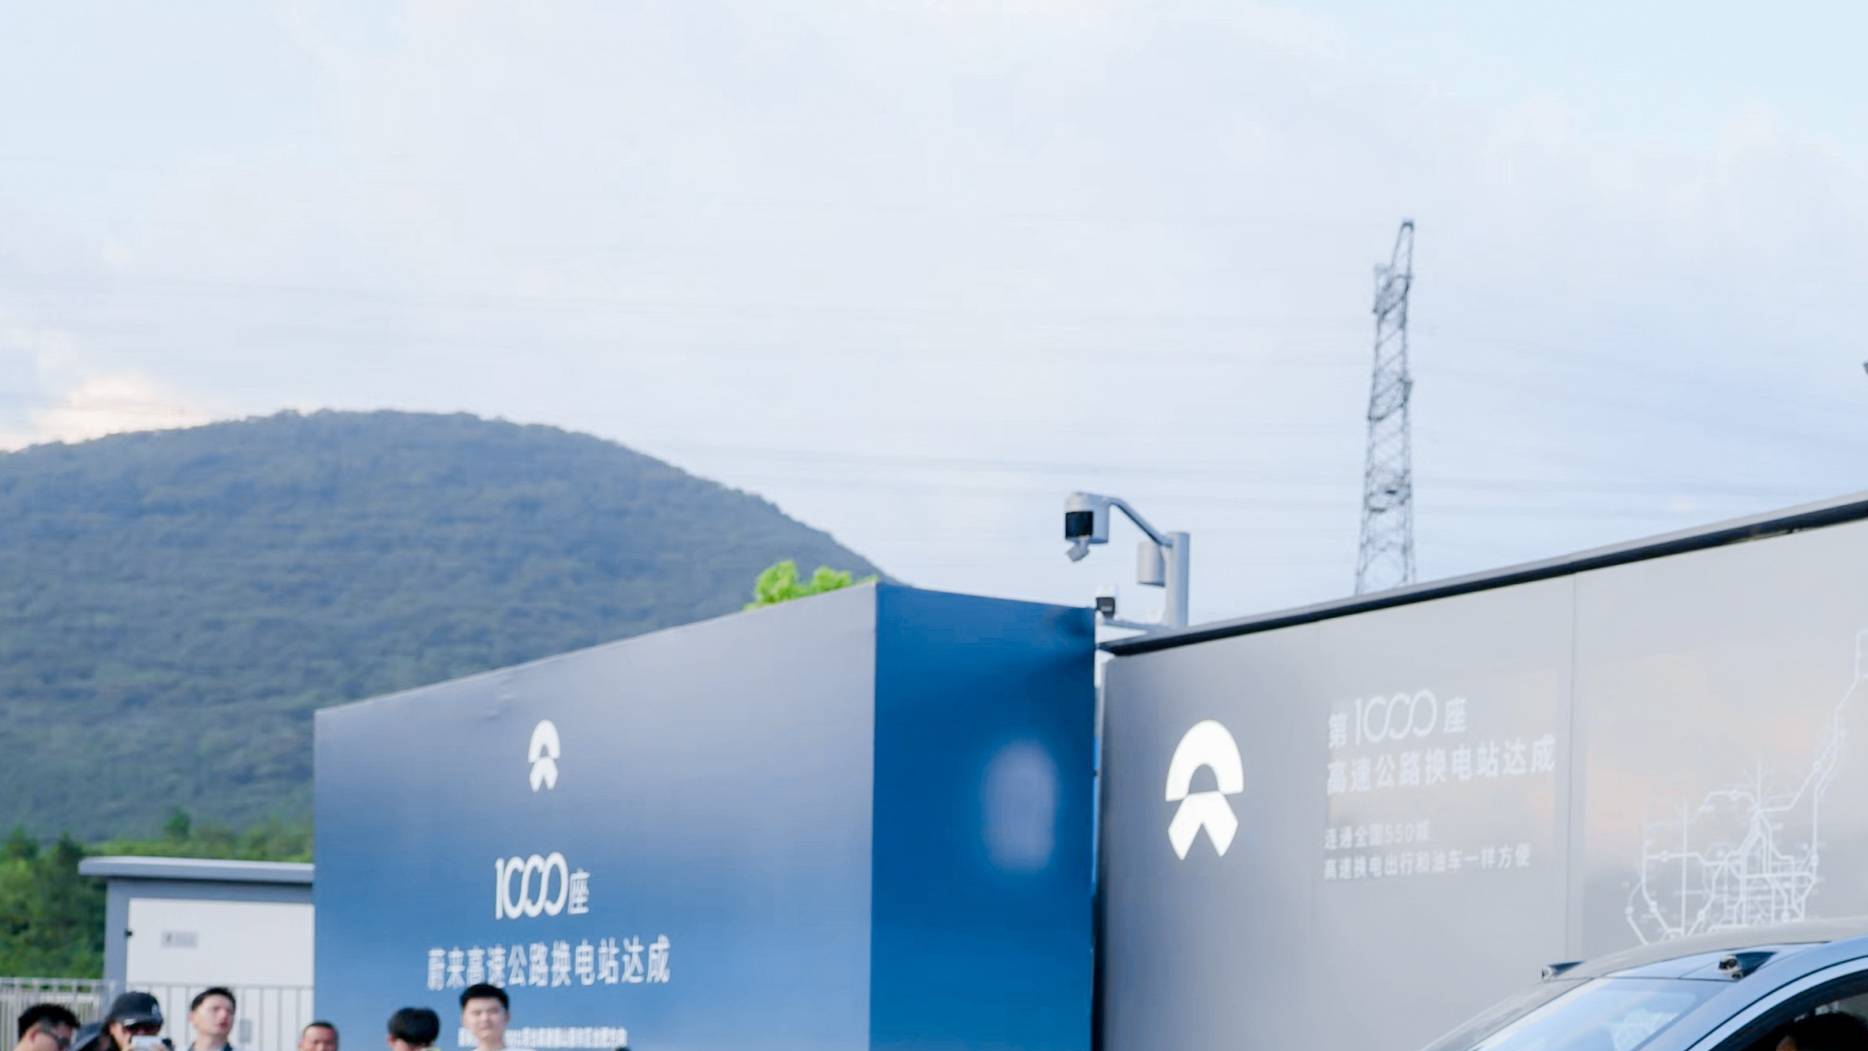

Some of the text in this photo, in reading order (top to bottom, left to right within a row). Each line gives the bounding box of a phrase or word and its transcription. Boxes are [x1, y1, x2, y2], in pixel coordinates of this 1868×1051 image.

[1327, 734, 1556, 795] 高速公路换电站达成
[495, 852, 590, 920] 1000座
[427, 934, 671, 991] 蔚来高速公路换电站达成
